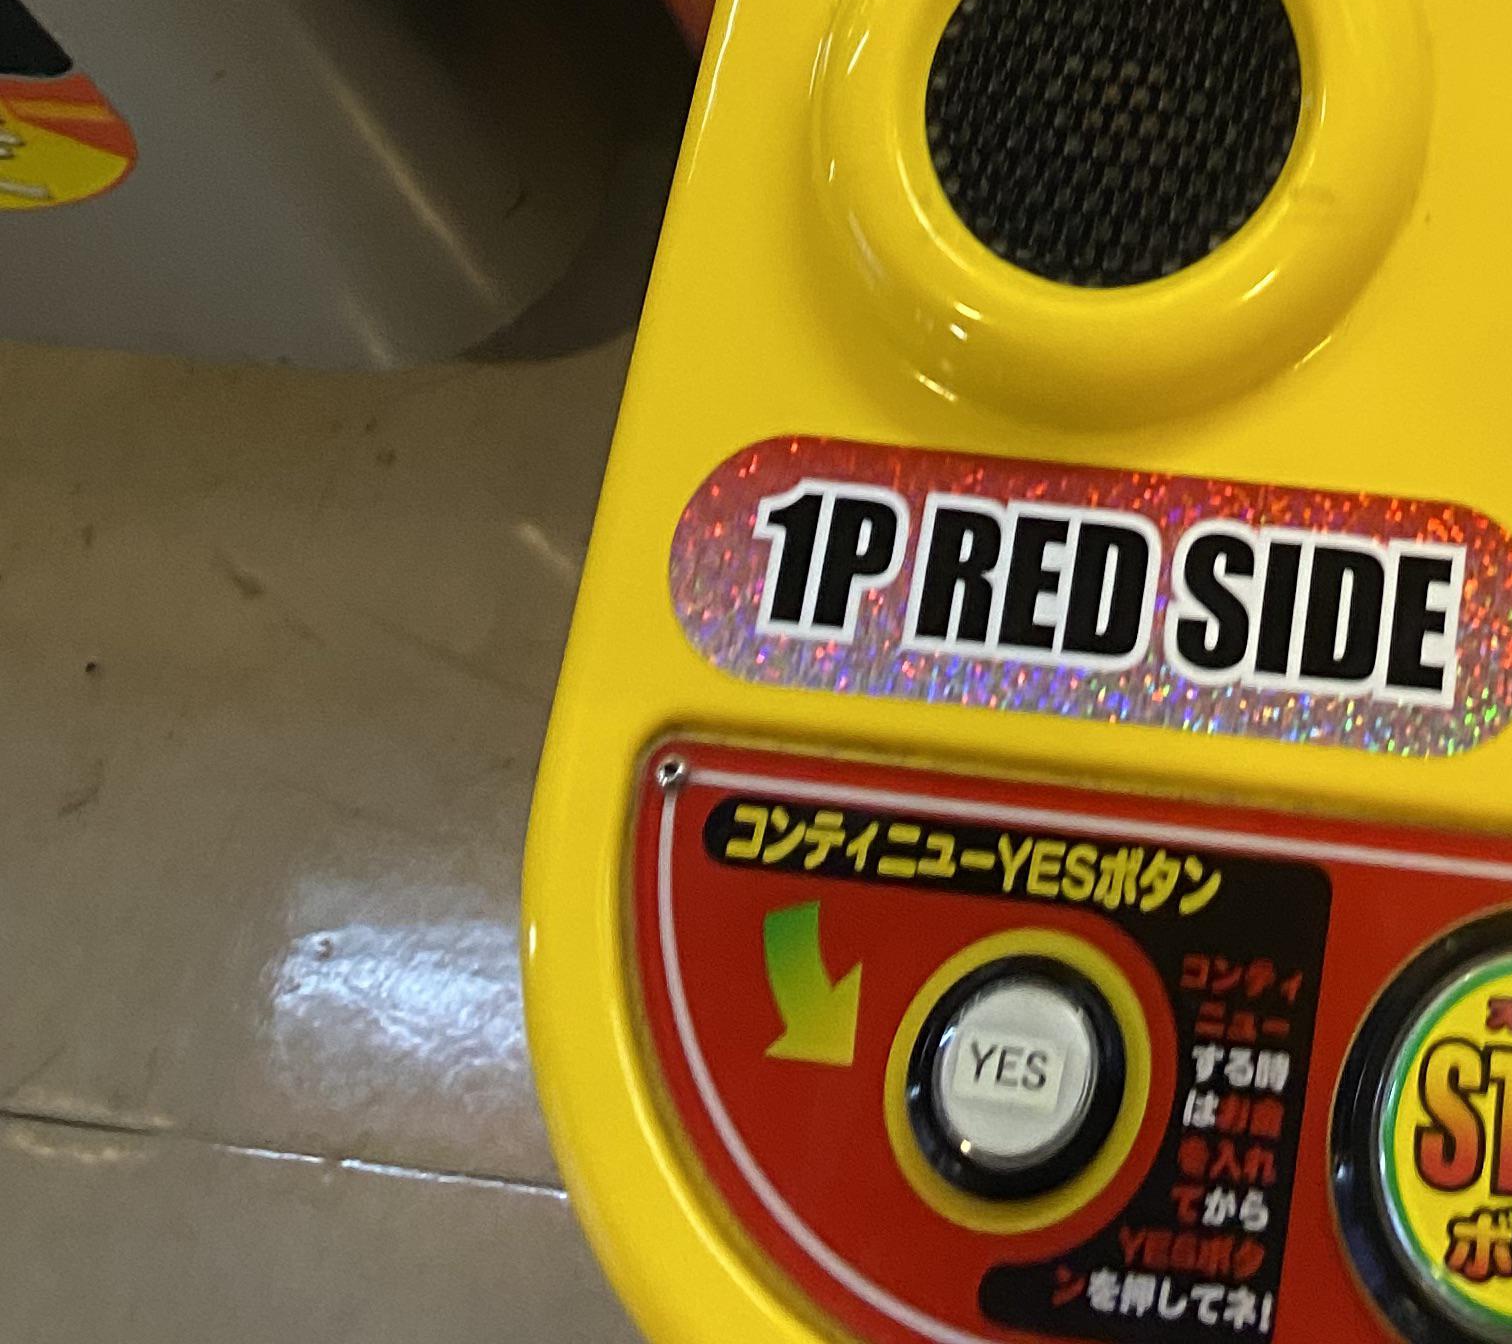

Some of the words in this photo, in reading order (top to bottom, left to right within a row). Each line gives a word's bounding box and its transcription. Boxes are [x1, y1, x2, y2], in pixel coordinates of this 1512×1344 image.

[766, 491, 898, 632] 1P
[914, 505, 1151, 656] RED
[1175, 534, 1456, 693] SIDE
[724, 803, 1222, 915] コンティニューYESボタン
[970, 1039, 1047, 1091] YES
